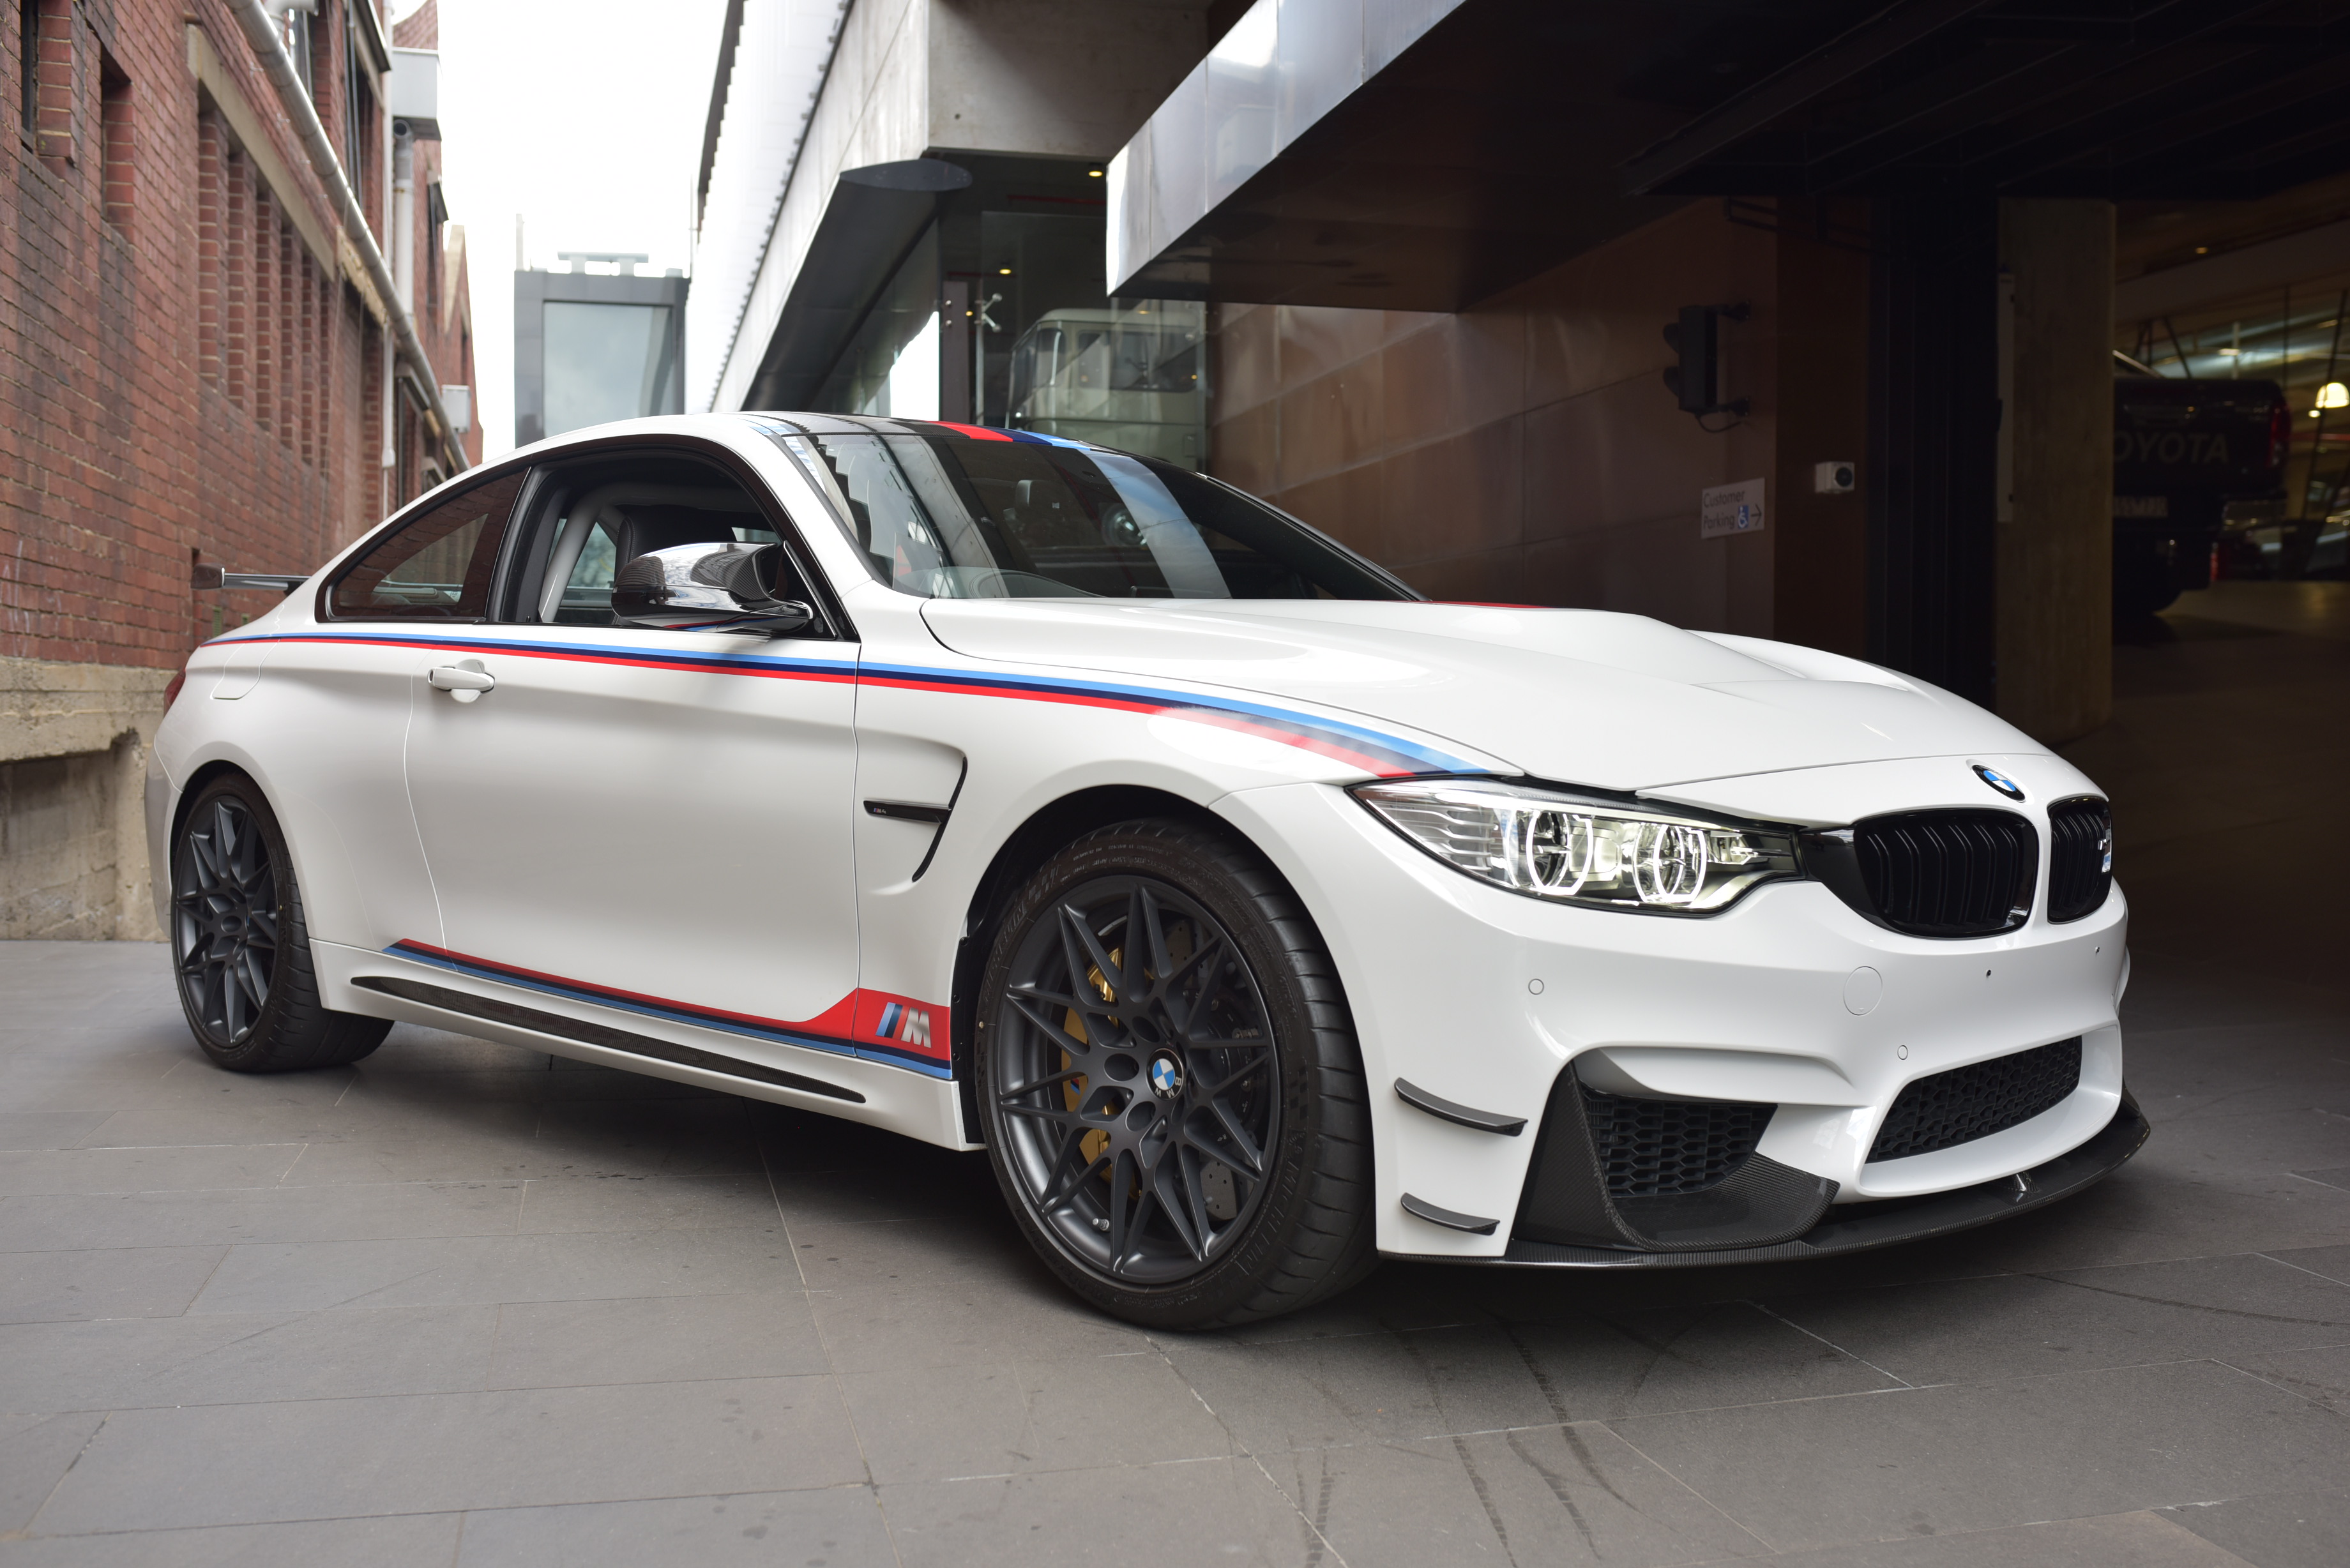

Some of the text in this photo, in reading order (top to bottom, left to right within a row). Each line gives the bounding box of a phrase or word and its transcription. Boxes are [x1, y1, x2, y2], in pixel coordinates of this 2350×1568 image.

[2114, 430, 2229, 465] OYOTA
[1703, 490, 1745, 508] Customer
[1703, 511, 1735, 531] Parking
[1155, 1076, 1182, 1099] BMW
